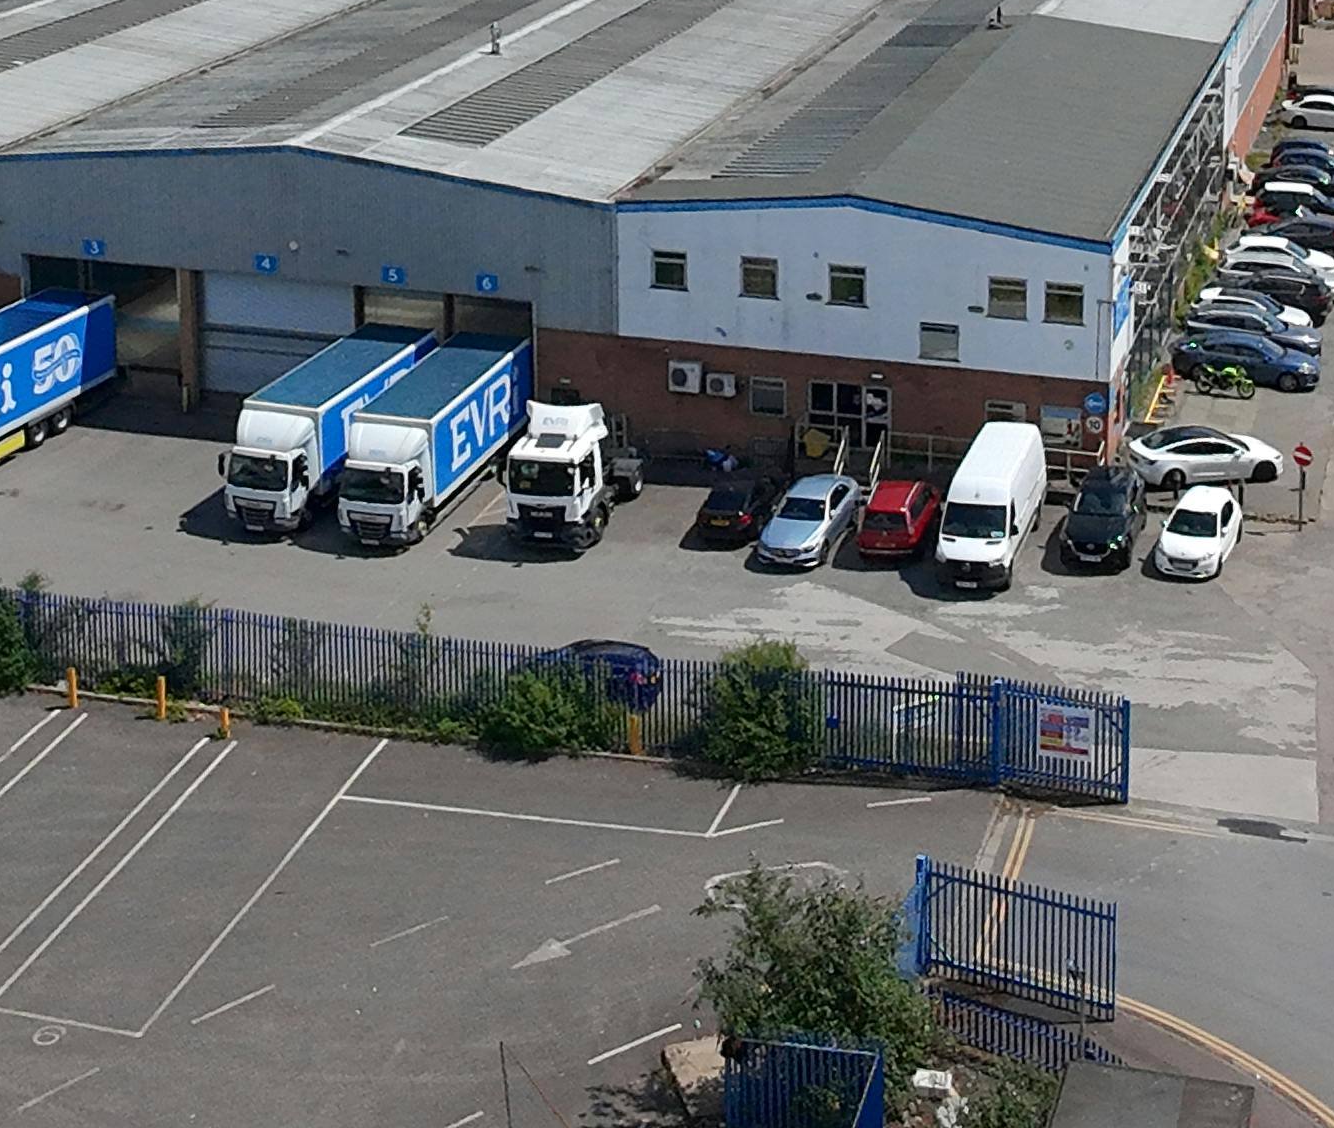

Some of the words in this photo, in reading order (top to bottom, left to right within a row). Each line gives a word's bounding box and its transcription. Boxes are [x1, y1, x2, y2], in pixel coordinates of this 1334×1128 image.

[90, 240, 100, 254] 3
[261, 257, 271, 270] 4
[388, 268, 399, 282] 5
[482, 277, 492, 290] 6
